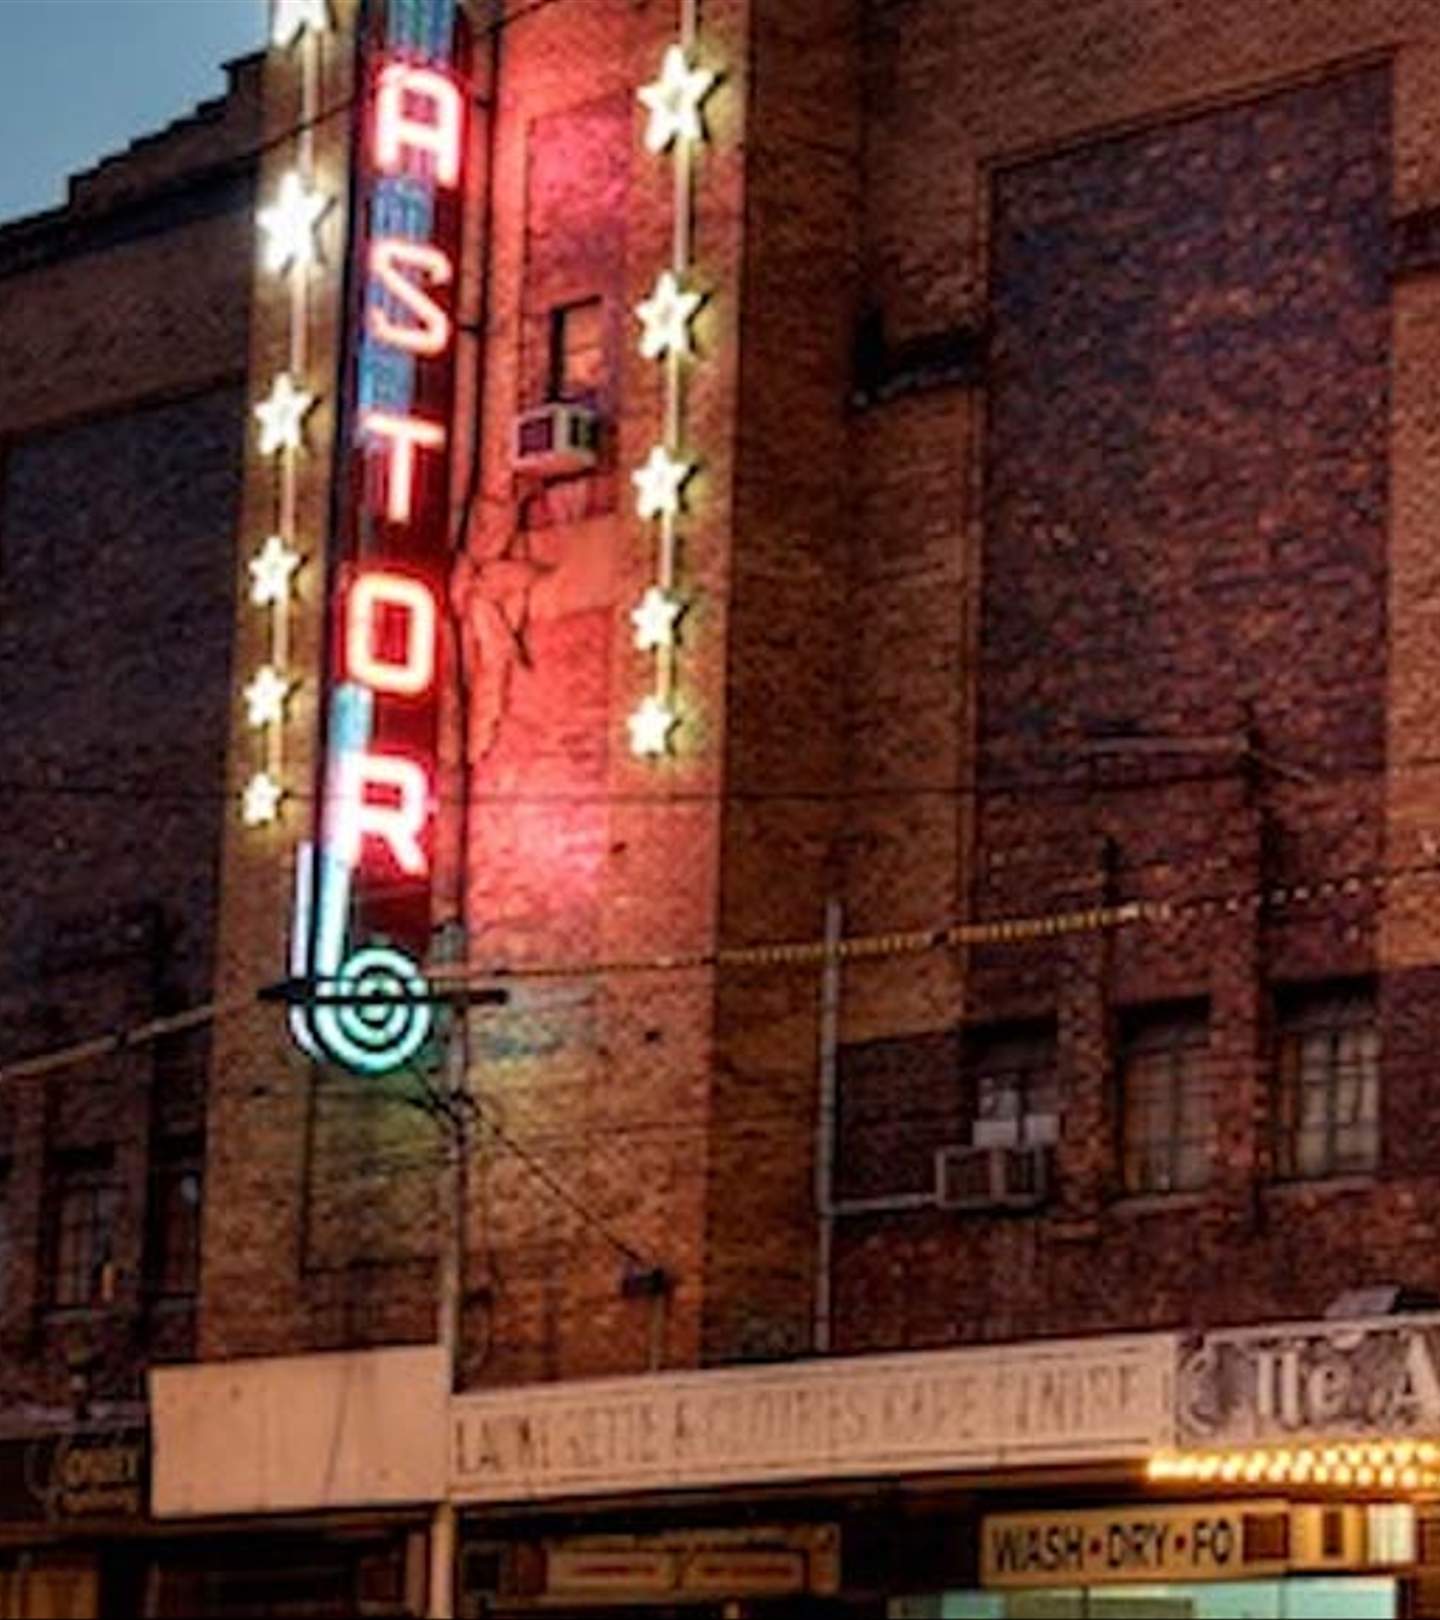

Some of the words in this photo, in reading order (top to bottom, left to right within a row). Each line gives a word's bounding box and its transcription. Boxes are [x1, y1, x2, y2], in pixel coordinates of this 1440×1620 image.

[338, 62, 463, 878] ASTOR
[990, 1525, 1084, 1572] WASH
[1108, 1521, 1168, 1567] DRY
